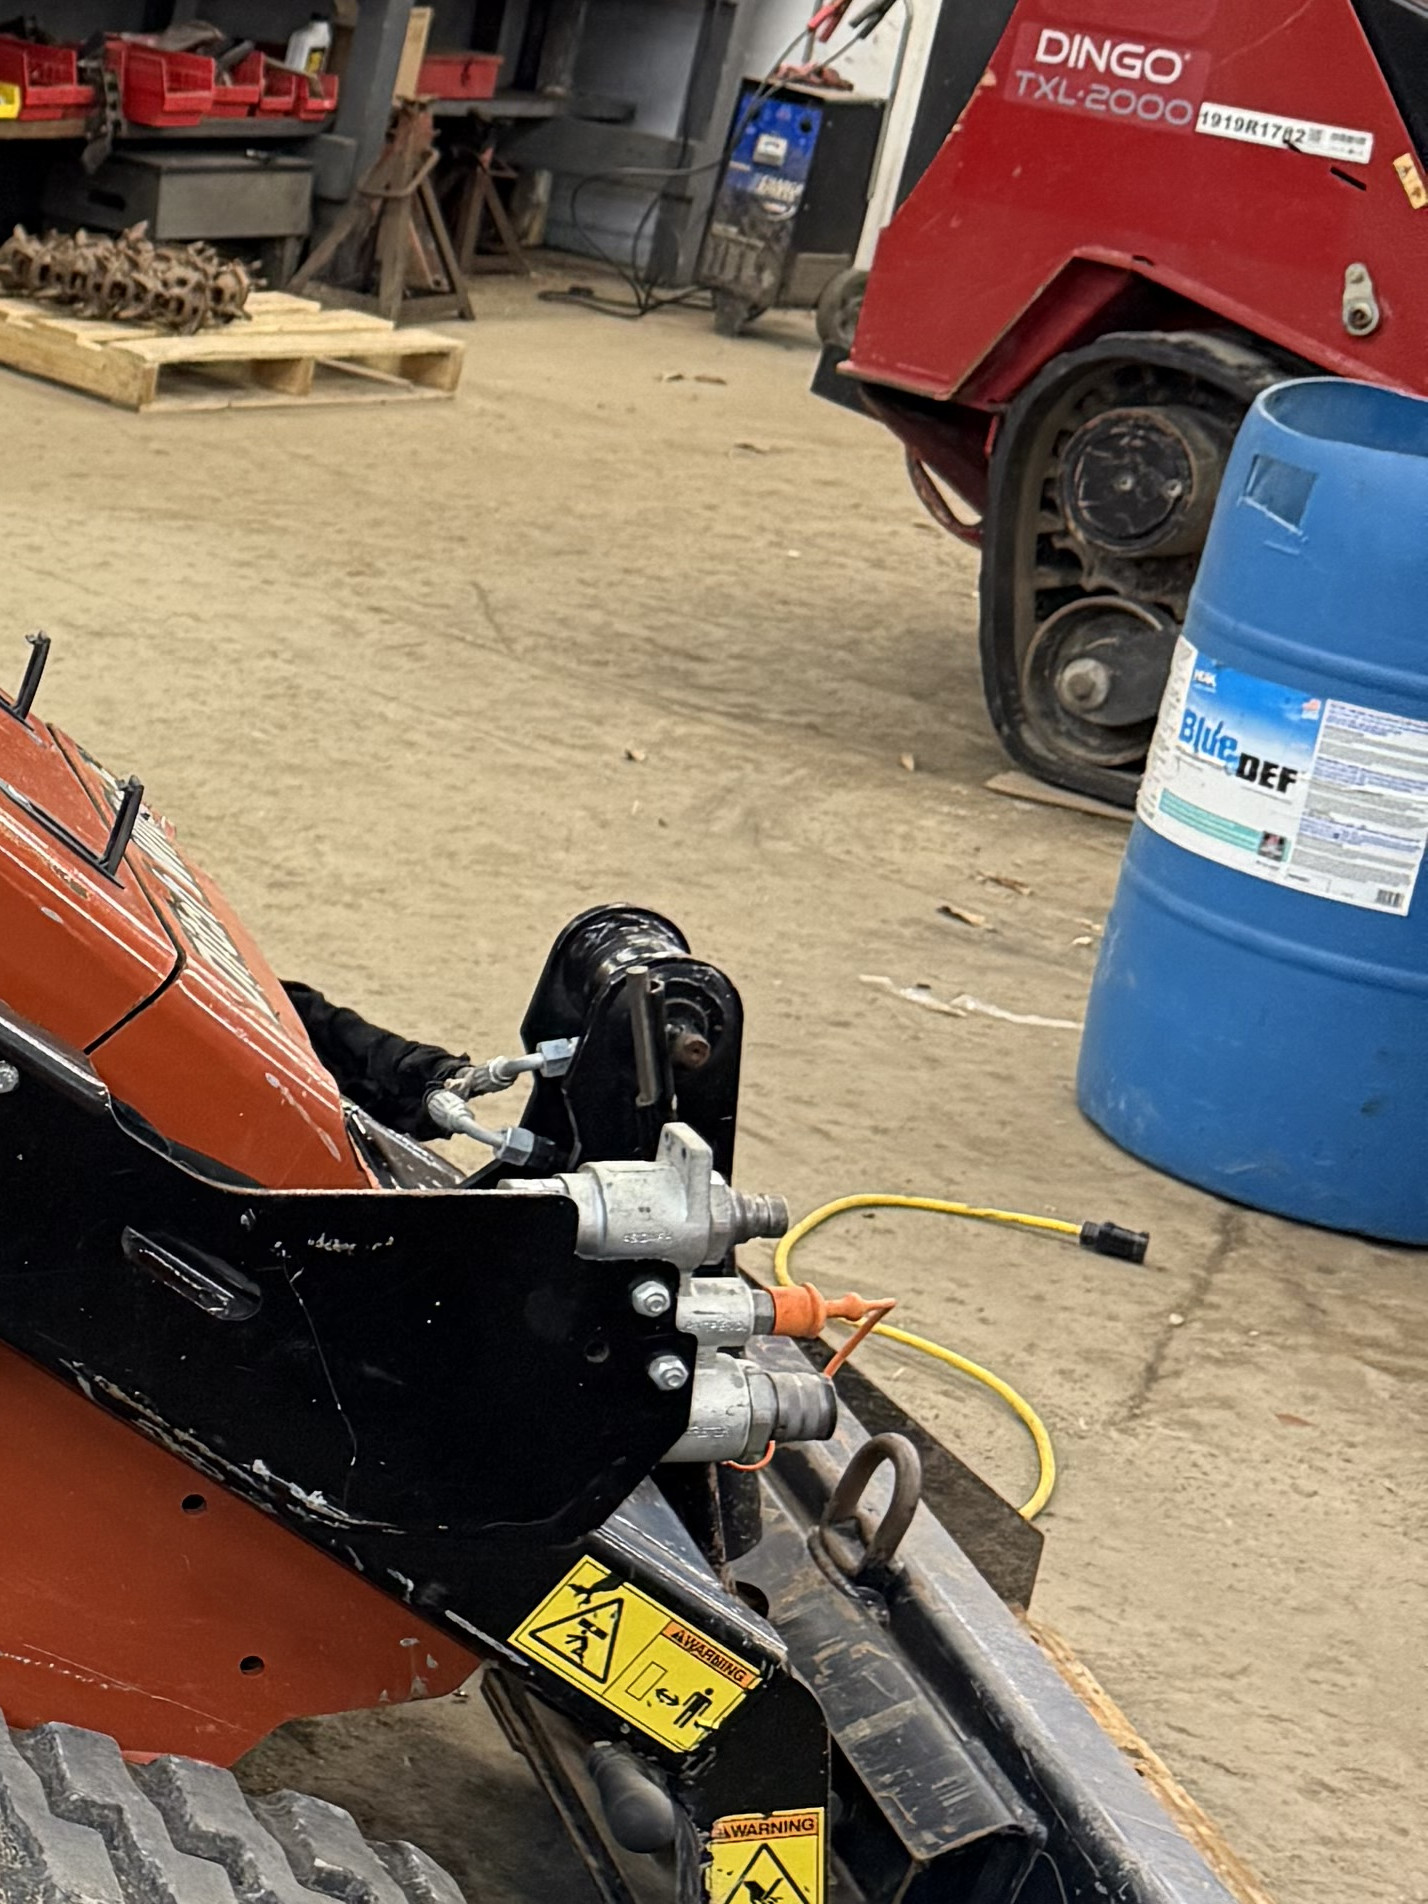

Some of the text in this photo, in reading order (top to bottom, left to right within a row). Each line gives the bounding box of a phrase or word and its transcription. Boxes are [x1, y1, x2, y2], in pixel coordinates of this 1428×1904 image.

[1035, 29, 1183, 84] DINGO
[1178, 708, 1299, 794] Blue DEF
[682, 1630, 748, 1684] WARNING
[730, 1816, 816, 1839] WARNING
